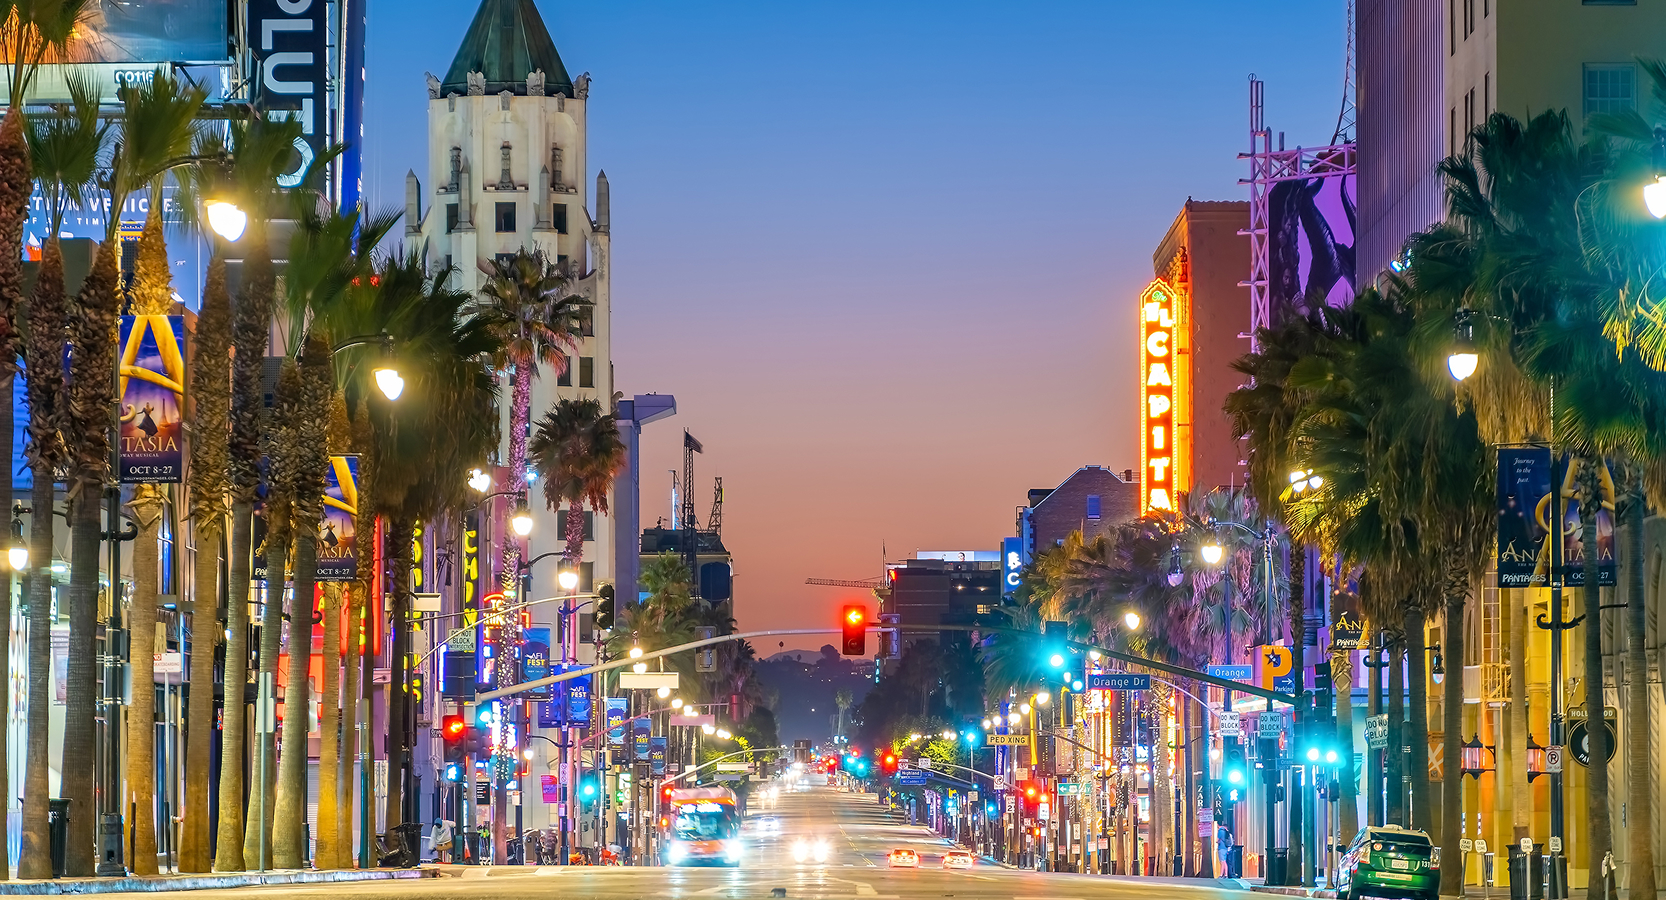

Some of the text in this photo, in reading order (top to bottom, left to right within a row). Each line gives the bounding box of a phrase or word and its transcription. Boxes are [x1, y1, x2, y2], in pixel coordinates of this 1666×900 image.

[1147, 331, 1172, 511] CAPITA
[1514, 458, 1535, 466] Journey
[130, 466, 172, 474] OCT 8-27
[1502, 574, 1546, 582] PANTAGES
[1215, 669, 1244, 678] Orange
[1094, 678, 1129, 688] Orange
[1368, 720, 1377, 728] DO
[1370, 729, 1388, 739] BLOC
